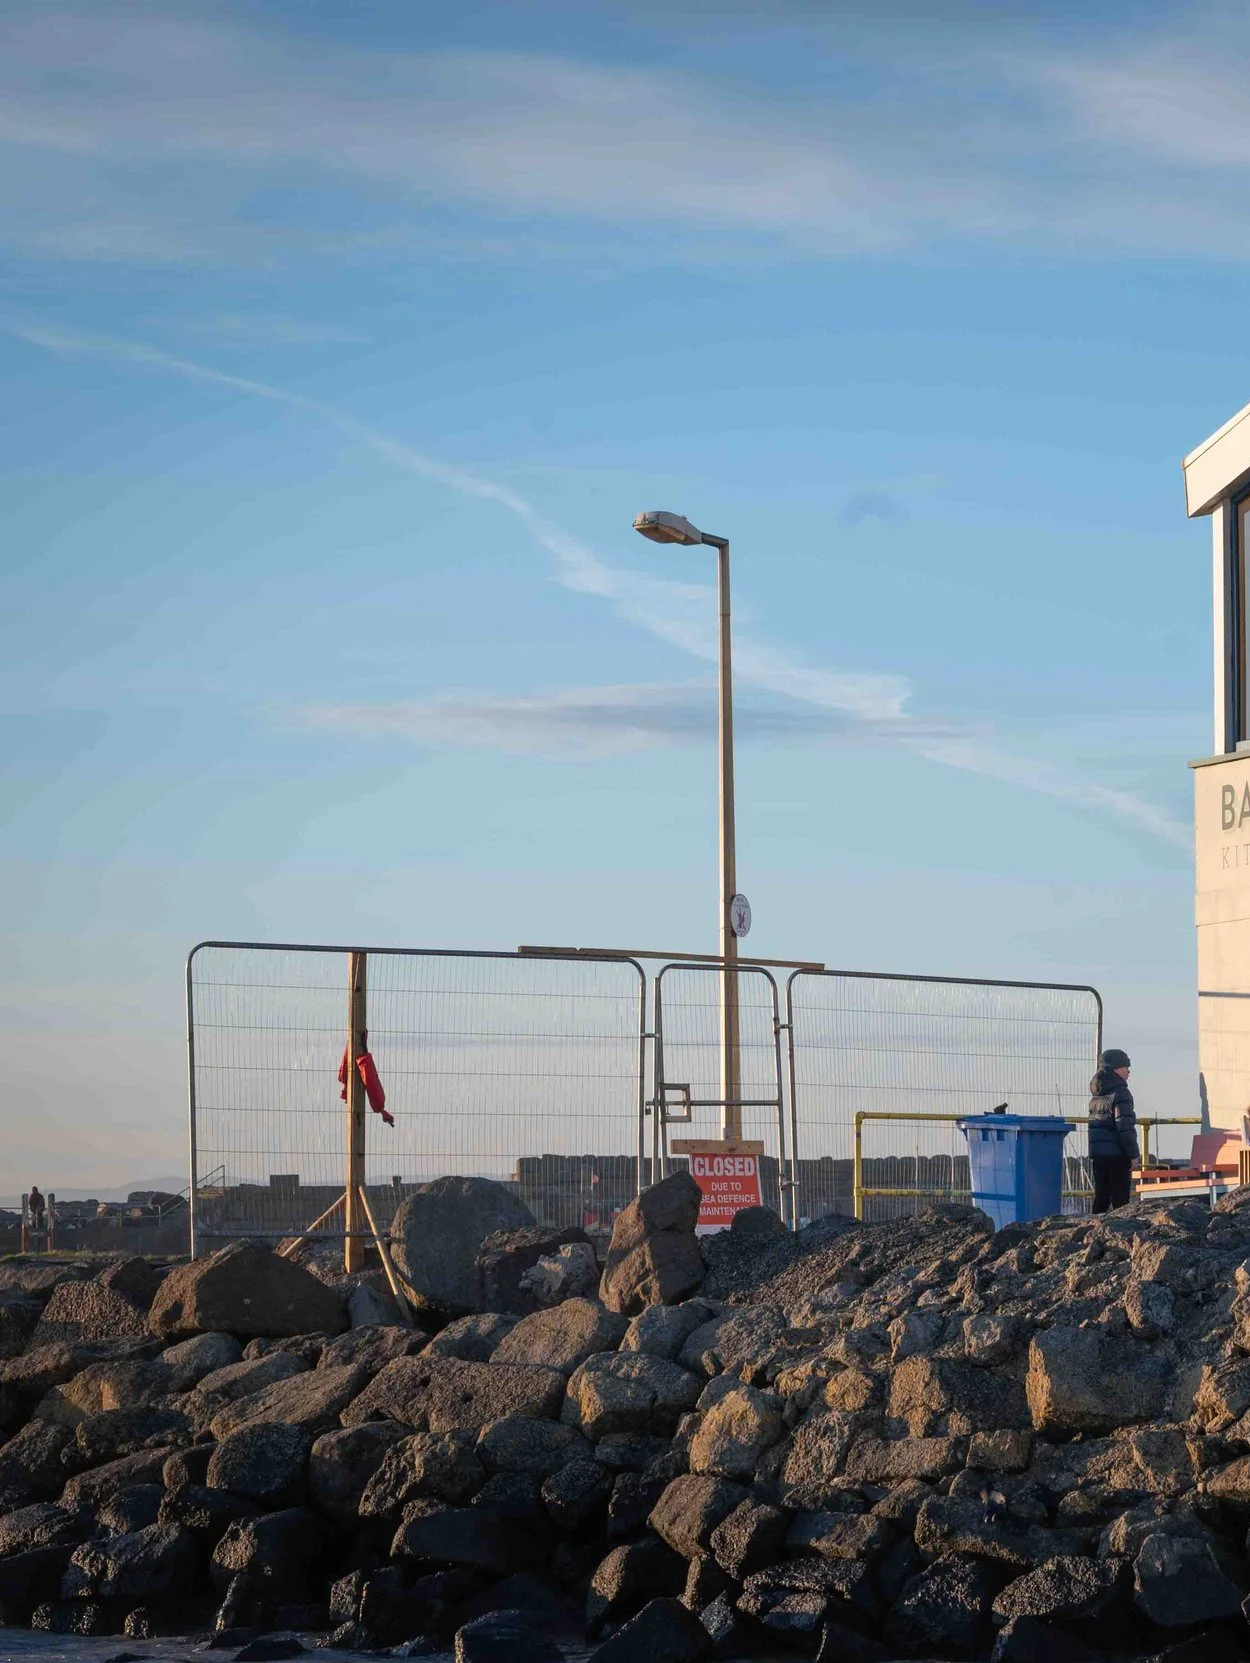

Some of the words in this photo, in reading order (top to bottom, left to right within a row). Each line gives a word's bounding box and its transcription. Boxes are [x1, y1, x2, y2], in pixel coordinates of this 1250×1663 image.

[694, 1157, 755, 1176] CLOSED
[711, 1182, 728, 1191] DUE
[730, 1182, 741, 1191] TO
[717, 1194, 756, 1203] DEFENCE
[699, 1206, 748, 1216] MAINTEN
